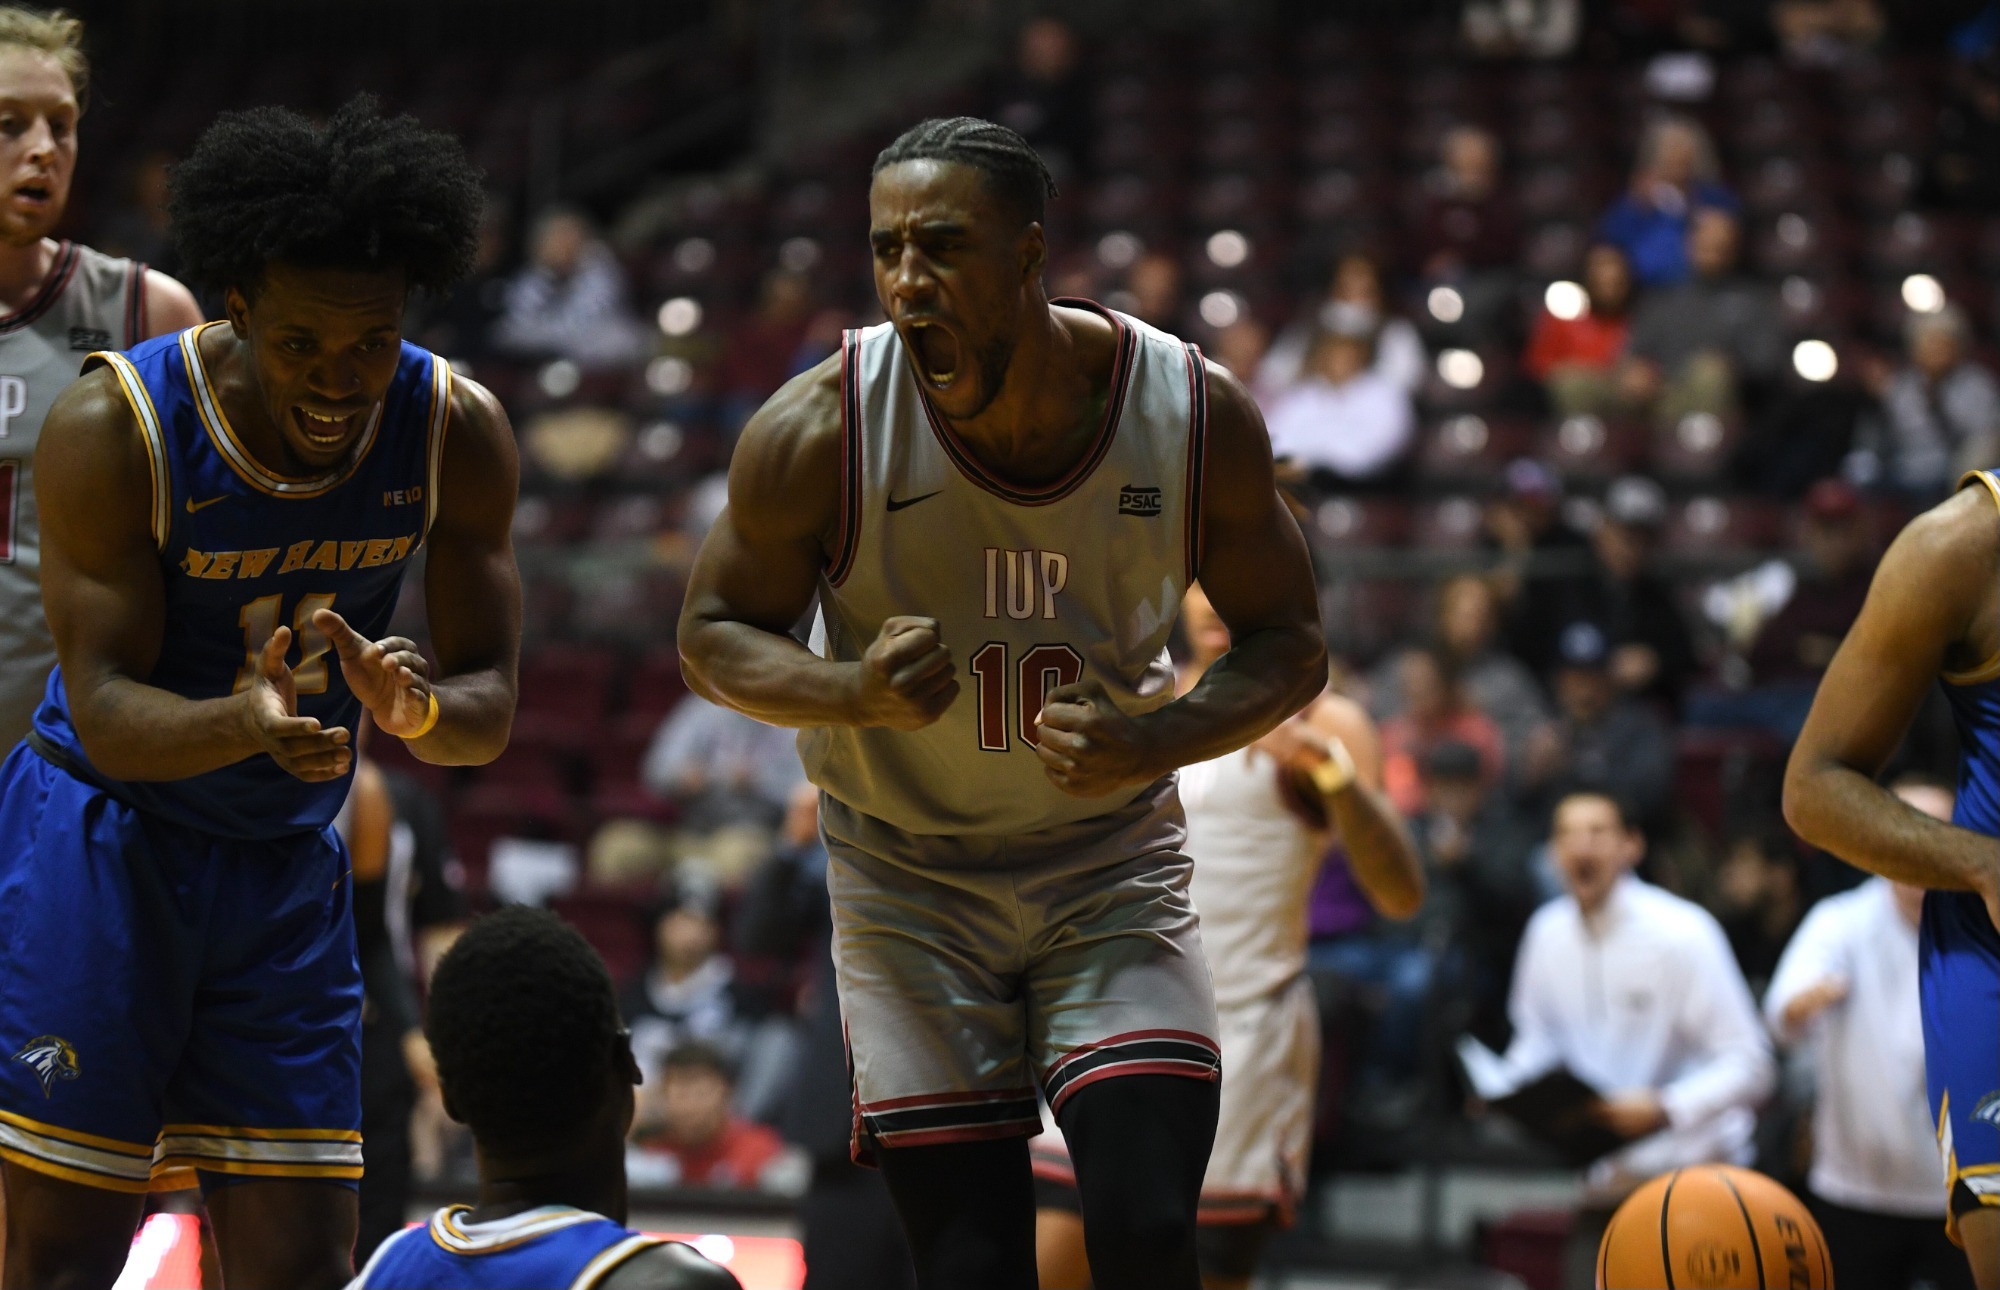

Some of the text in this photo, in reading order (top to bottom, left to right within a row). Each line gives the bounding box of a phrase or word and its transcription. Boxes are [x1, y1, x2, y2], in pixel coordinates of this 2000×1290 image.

[383, 486, 422, 507] NE10
[1118, 493, 1162, 508] PSAC
[180, 533, 417, 580] NEW HAVEN
[984, 547, 1069, 620] IUP
[969, 640, 1085, 752] 10
